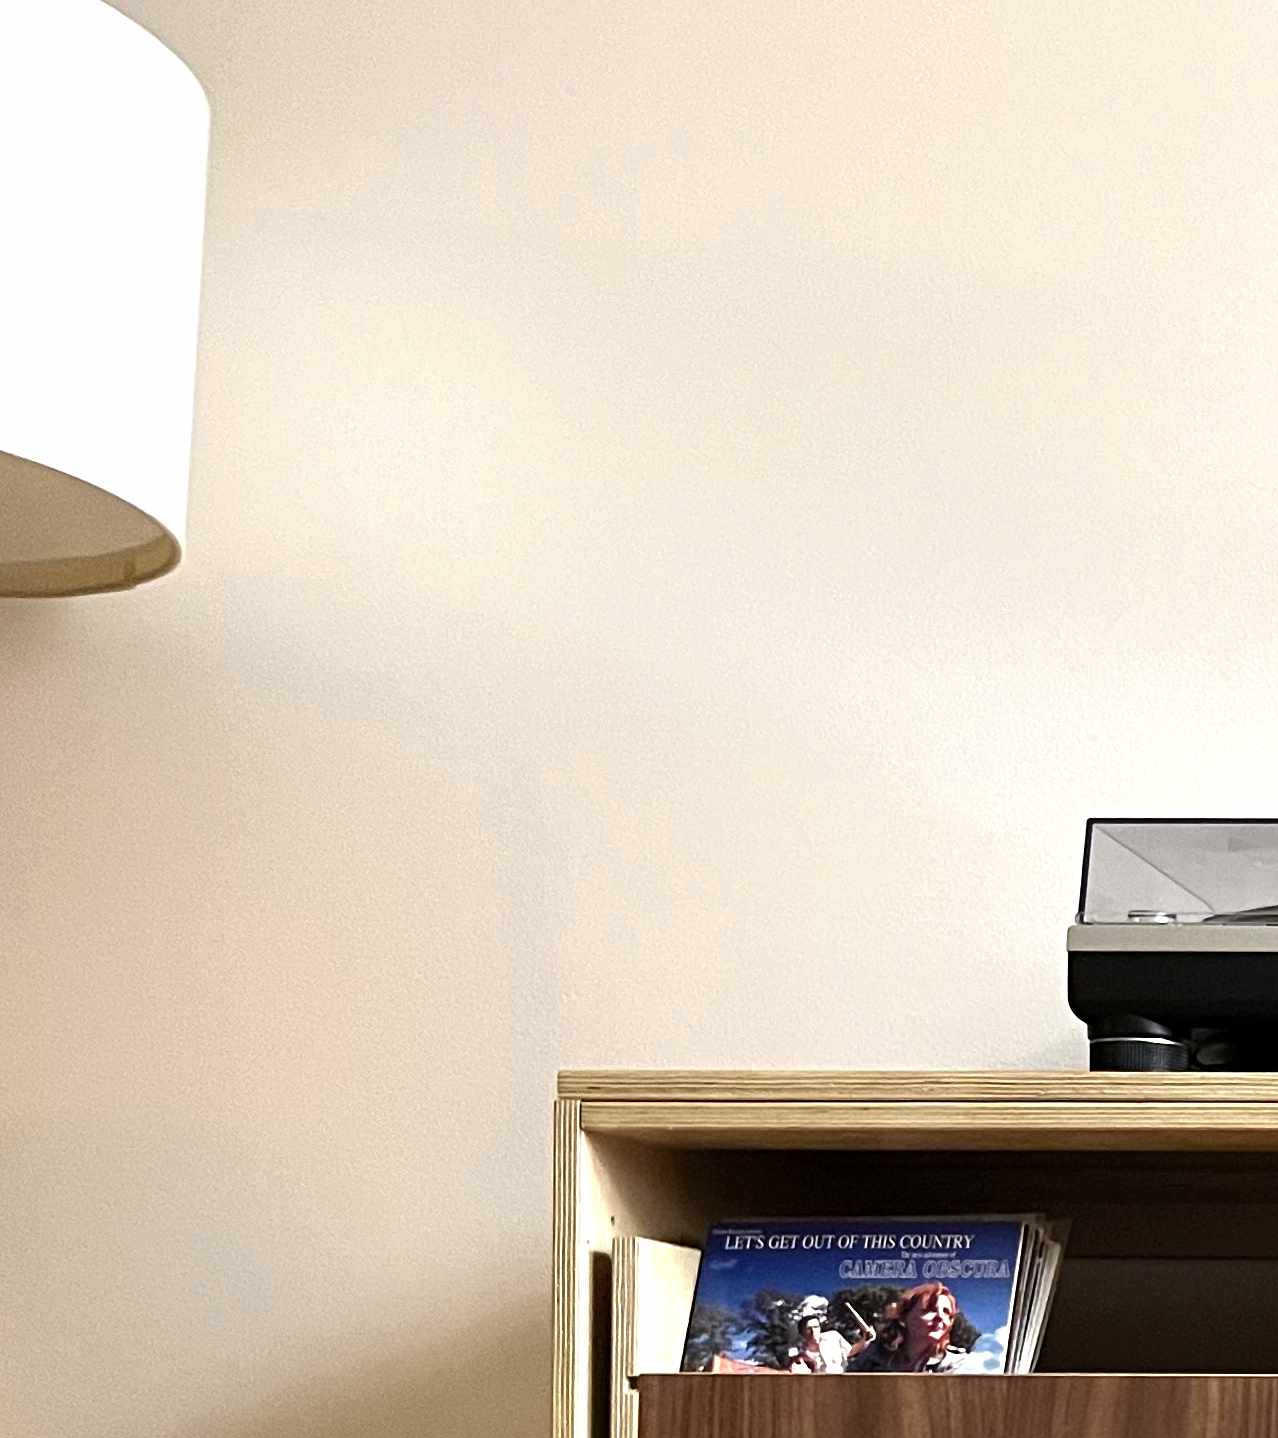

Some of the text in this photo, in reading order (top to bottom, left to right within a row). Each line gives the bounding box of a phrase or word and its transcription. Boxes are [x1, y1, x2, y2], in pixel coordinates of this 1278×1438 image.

[724, 1234, 976, 1251] LET'S GET OUT OF THIS COUNTRY
[838, 1260, 1011, 1280] CAMERA OBSCURA
